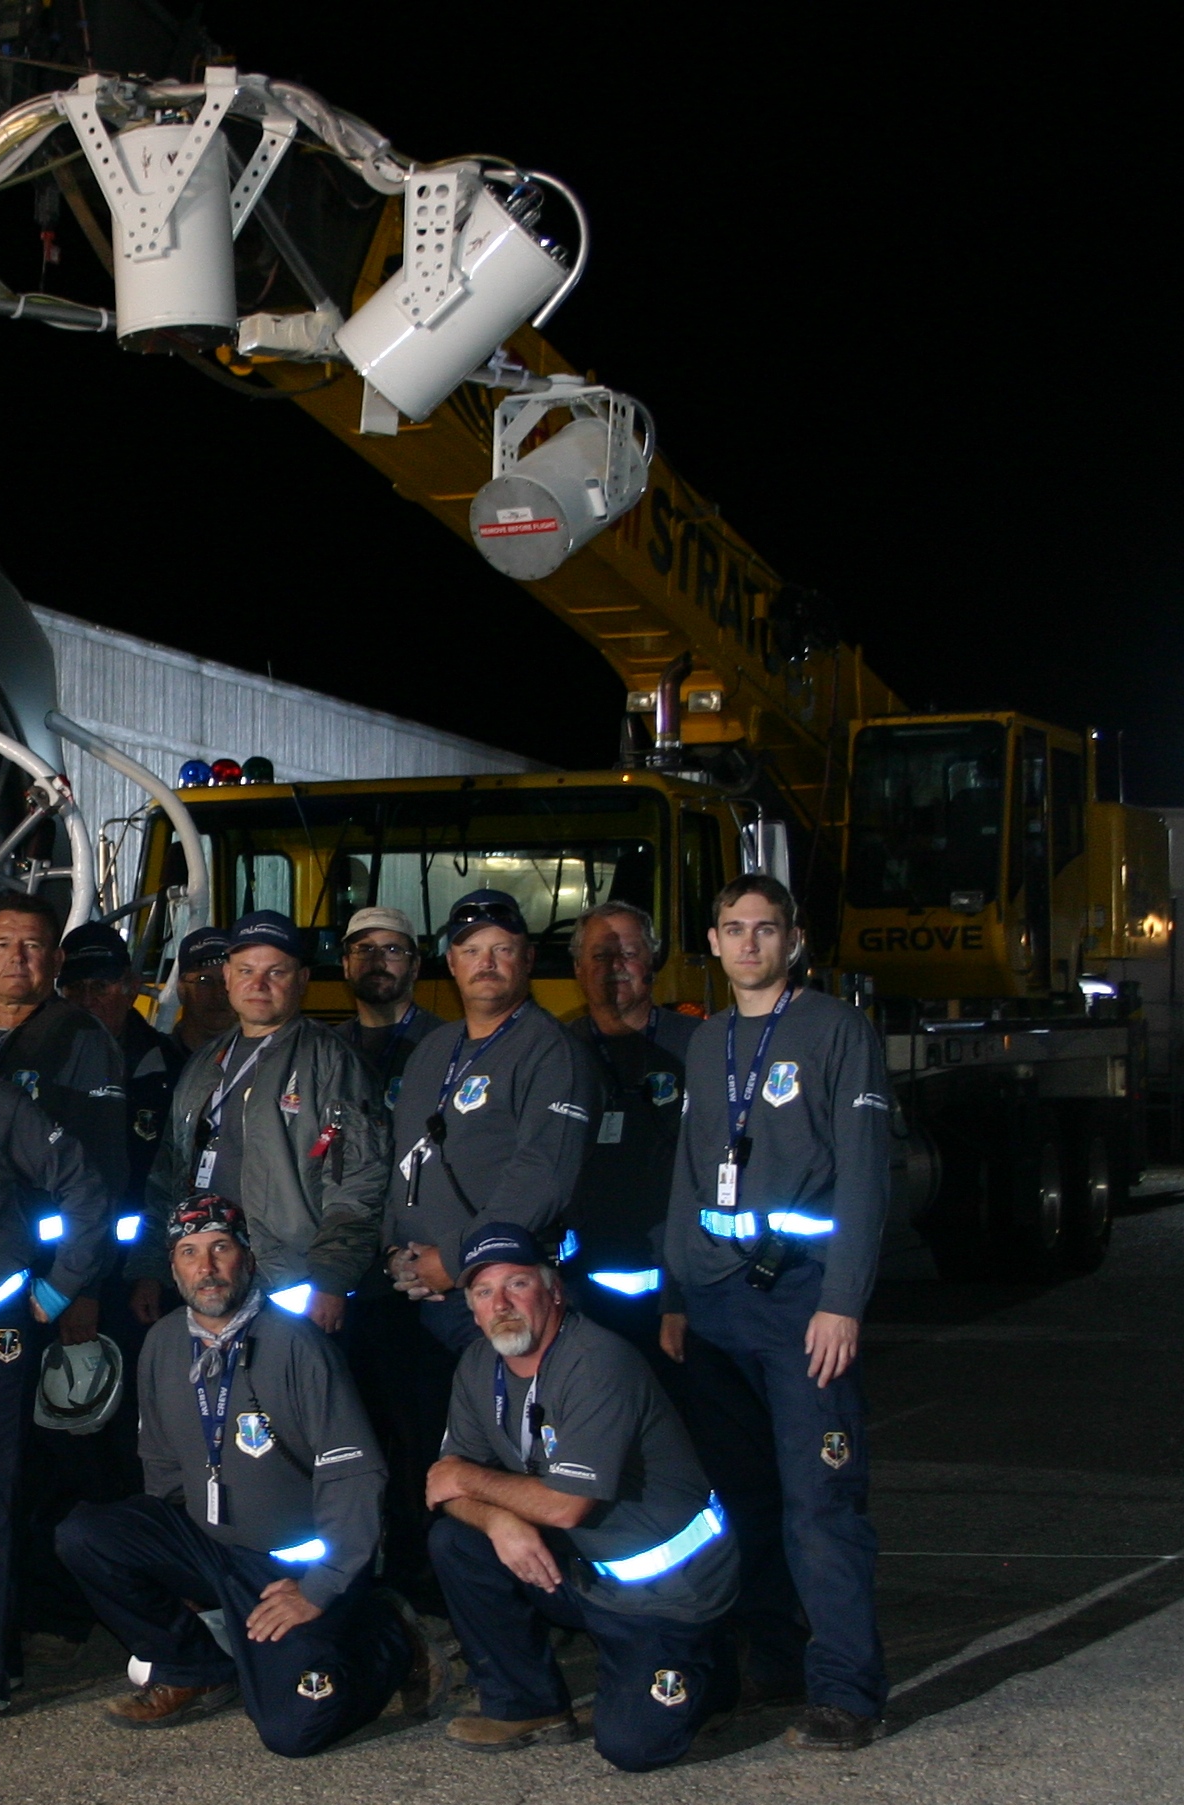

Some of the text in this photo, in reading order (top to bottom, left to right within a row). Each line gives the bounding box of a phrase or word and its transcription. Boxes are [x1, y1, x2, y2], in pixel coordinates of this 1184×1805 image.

[860, 925, 984, 952] GROVE
[727, 1074, 737, 1102] CREW
[743, 1071, 757, 1101] CREW
[197, 1387, 210, 1416] CREW
[216, 1386, 228, 1417] CREW
